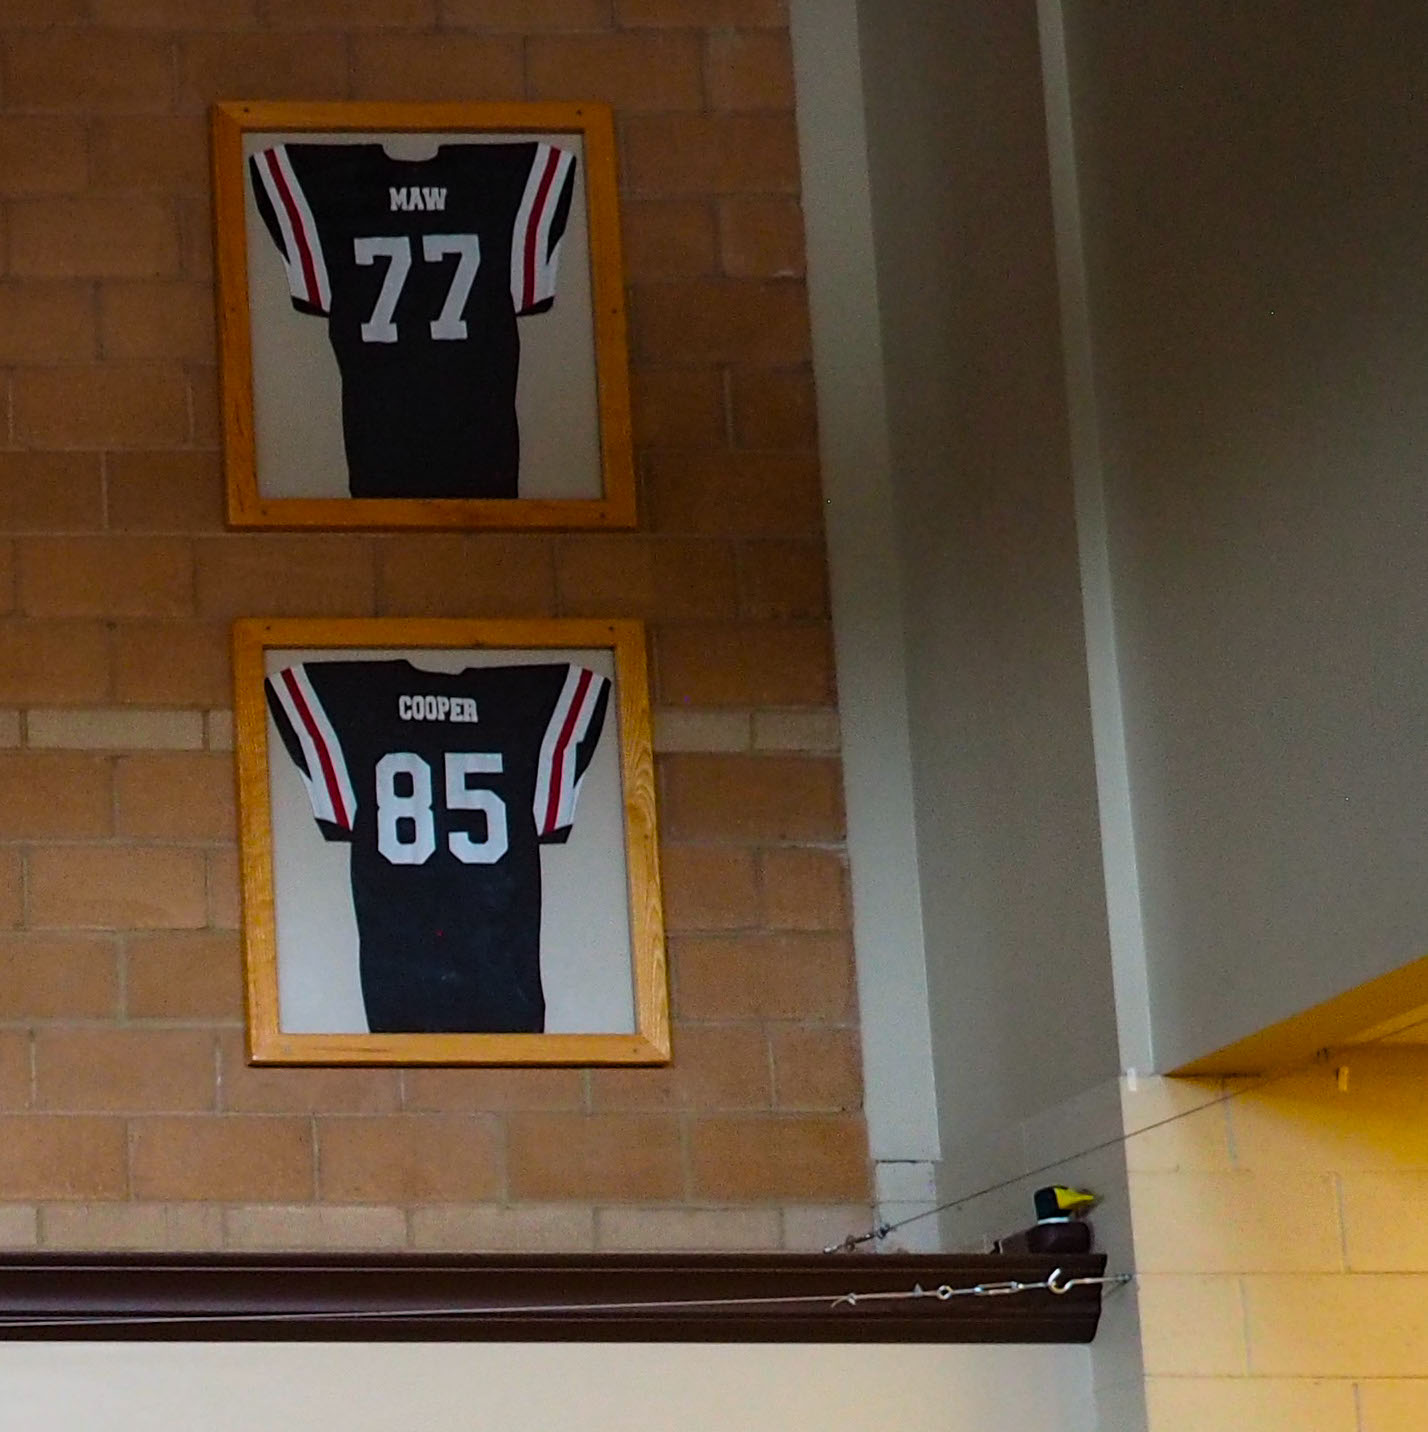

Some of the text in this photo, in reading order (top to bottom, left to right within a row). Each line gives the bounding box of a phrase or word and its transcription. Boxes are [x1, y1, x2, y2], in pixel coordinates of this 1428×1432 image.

[389, 186, 448, 212] MAW
[353, 233, 481, 343] 77
[398, 695, 479, 723] COOPER
[375, 752, 509, 865] 85
